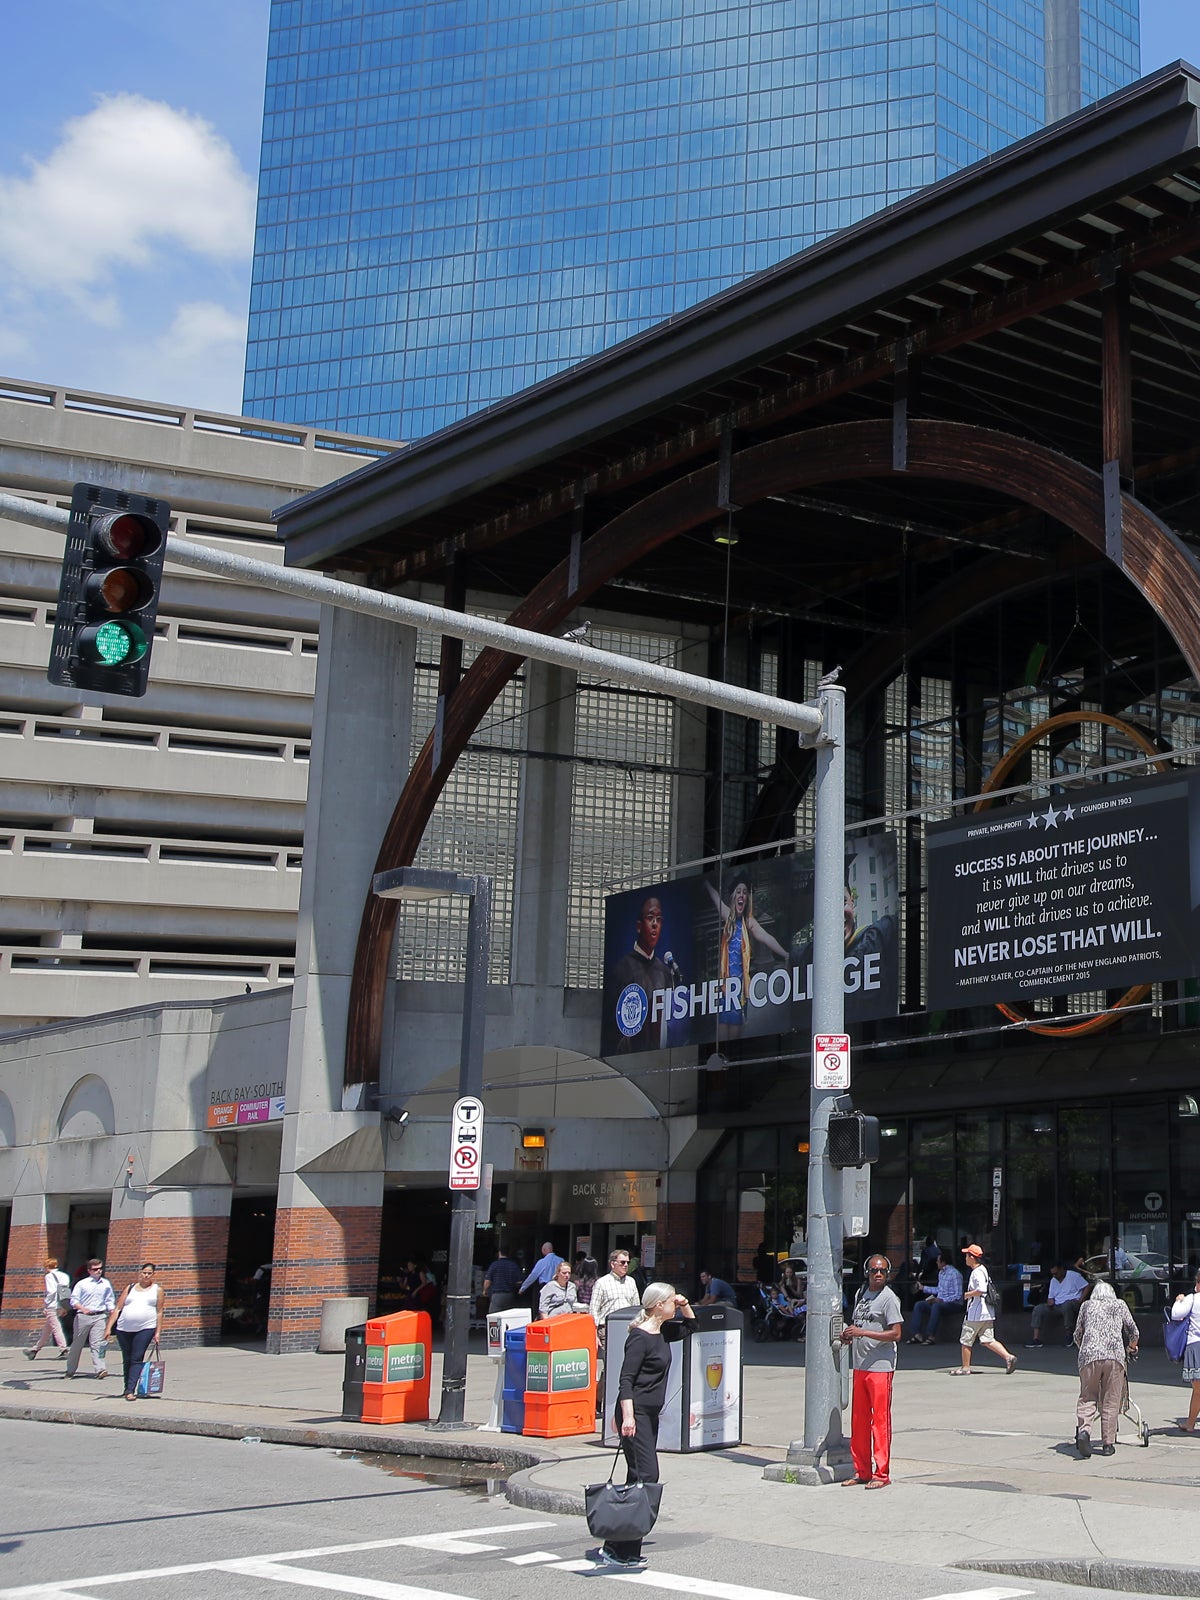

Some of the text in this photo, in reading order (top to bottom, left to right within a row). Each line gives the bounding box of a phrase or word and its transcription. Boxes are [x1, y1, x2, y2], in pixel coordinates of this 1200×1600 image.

[1080, 797, 1132, 813] FOUNDED IN 1903
[967, 820, 1023, 838] PRIVATE, NON-PROFIT
[954, 855, 1004, 878] SUCCESS
[1006, 853, 1017, 868] IS
[1018, 844, 1059, 865] ABOUT
[1060, 839, 1085, 857] THE
[982, 854, 1127, 892] it is WILL that drives us to
[976, 875, 1135, 914] never give up on our dreams,
[961, 893, 1153, 936] and WILL that drives us to achieve.
[954, 918, 1162, 968] NEVER LOSE THAT WILL.
[990, 971, 1014, 983] SLATER,
[1014, 966, 1053, 979] CO-CAPTAIN
[1054, 964, 1064, 973] OF
[1065, 962, 1077, 972] THE
[1078, 960, 1094, 970] NEW
[1095, 955, 1128, 968] ENGLAND
[1128, 950, 1162, 963] PATRIOTS,
[650, 952, 881, 1023] FISHER COLLGE
[1019, 971, 1091, 988] COMMENCEMENT 2015
[817, 1036, 848, 1044] TOW ZONE
[211, 1088, 233, 1105] BACK
[213, 1105, 234, 1116] ORANGE
[240, 1101, 269, 1112] COMMUTER
[217, 1115, 228, 1124] LINE
[247, 1112, 259, 1120] RAIL
[572, 1183, 597, 1196] BACK
[1129, 1212, 1168, 1220] INFORMATI
[391, 1354, 422, 1366] metro
[528, 1361, 548, 1374] metro
[555, 1360, 587, 1373] metro
